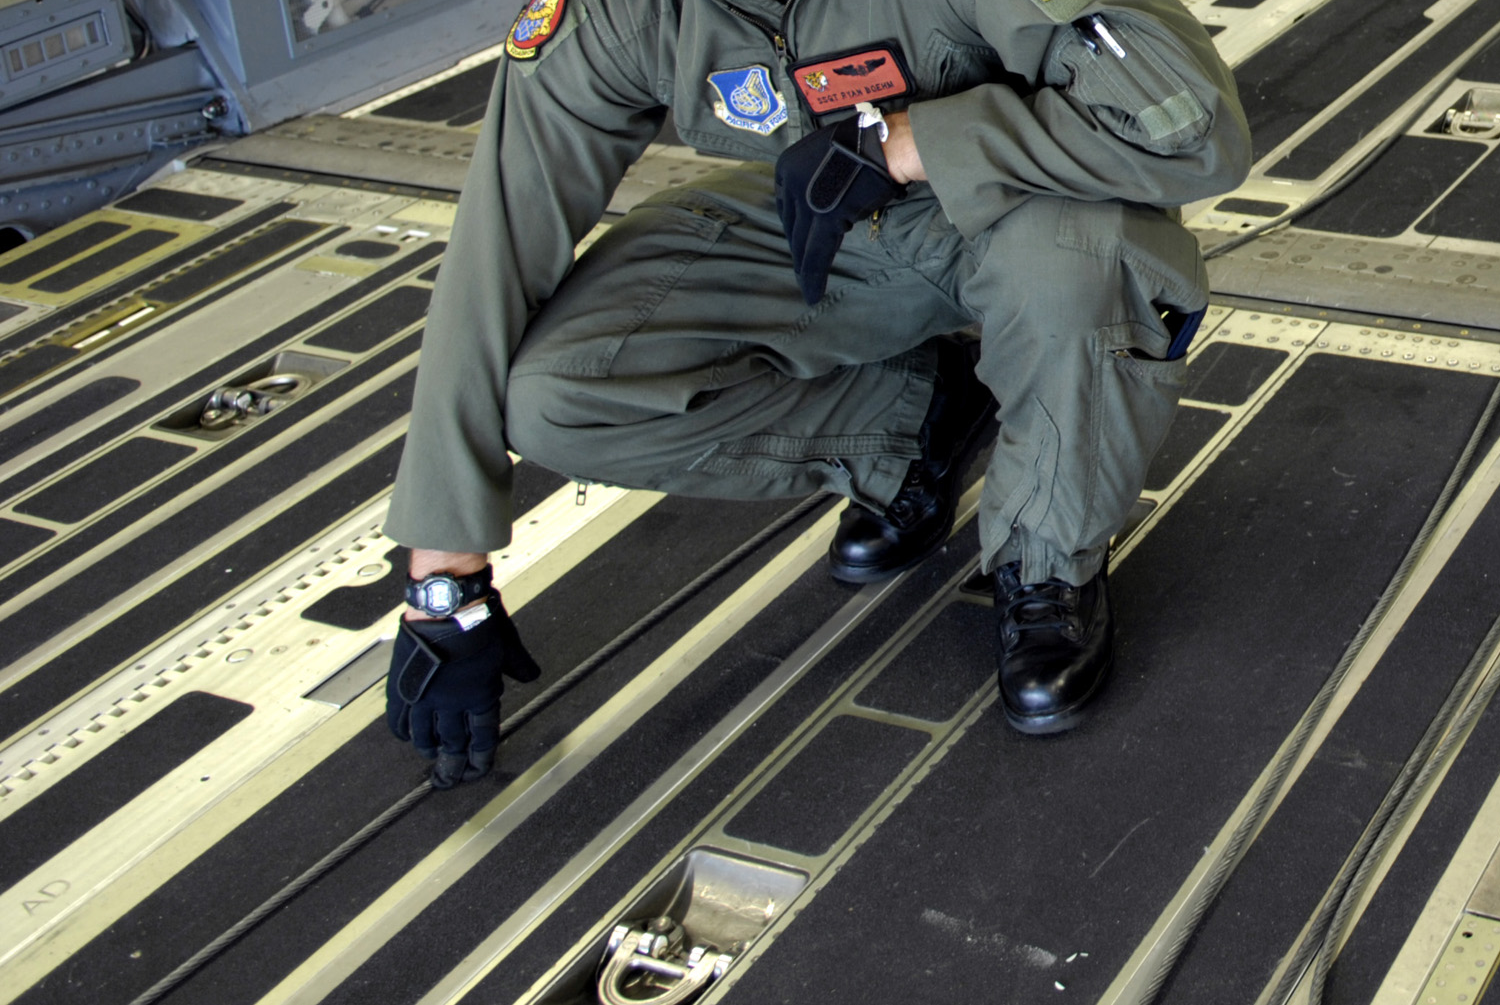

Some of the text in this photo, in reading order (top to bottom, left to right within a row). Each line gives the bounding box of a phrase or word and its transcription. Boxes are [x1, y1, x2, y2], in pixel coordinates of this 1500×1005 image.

[817, 80, 895, 104] SSGT RYAN BOEHM
[725, 115, 755, 129] PACIFIC
[757, 122, 771, 133] AIR
[22, 879, 71, 917] AD
